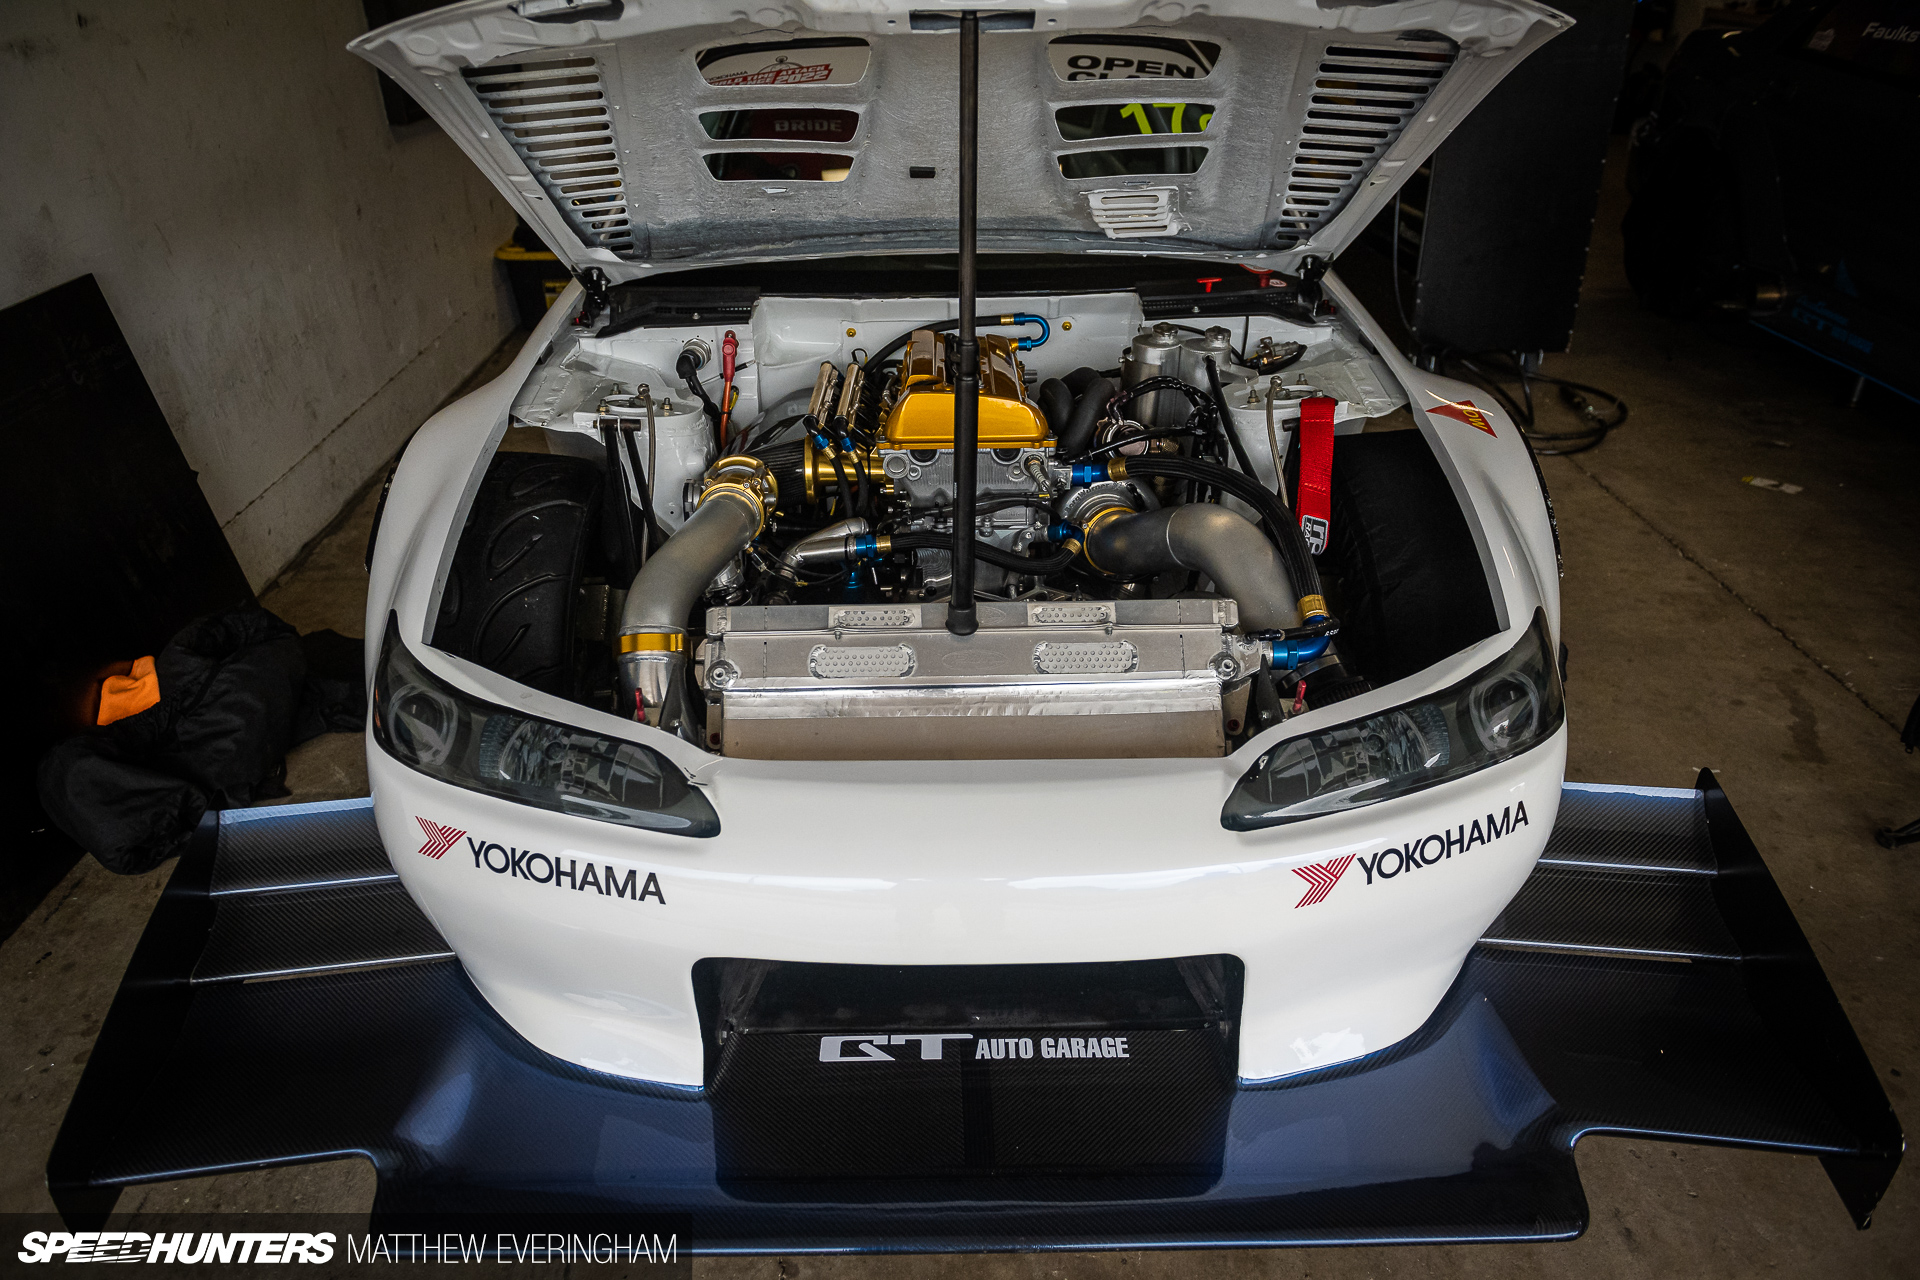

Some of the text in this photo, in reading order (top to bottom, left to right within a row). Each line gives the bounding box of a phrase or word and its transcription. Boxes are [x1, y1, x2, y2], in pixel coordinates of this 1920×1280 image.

[775, 70, 829, 84] 2022
[779, 66, 826, 75] ATTACK
[1067, 55, 1196, 79] OPEN
[774, 119, 842, 131] BRIDE
[1463, 404, 1488, 430] OW
[1356, 800, 1529, 886] YOKOHAMA
[466, 836, 667, 906] YOKOHAMA
[819, 1033, 1130, 1062] GT AUTO GARAGE
